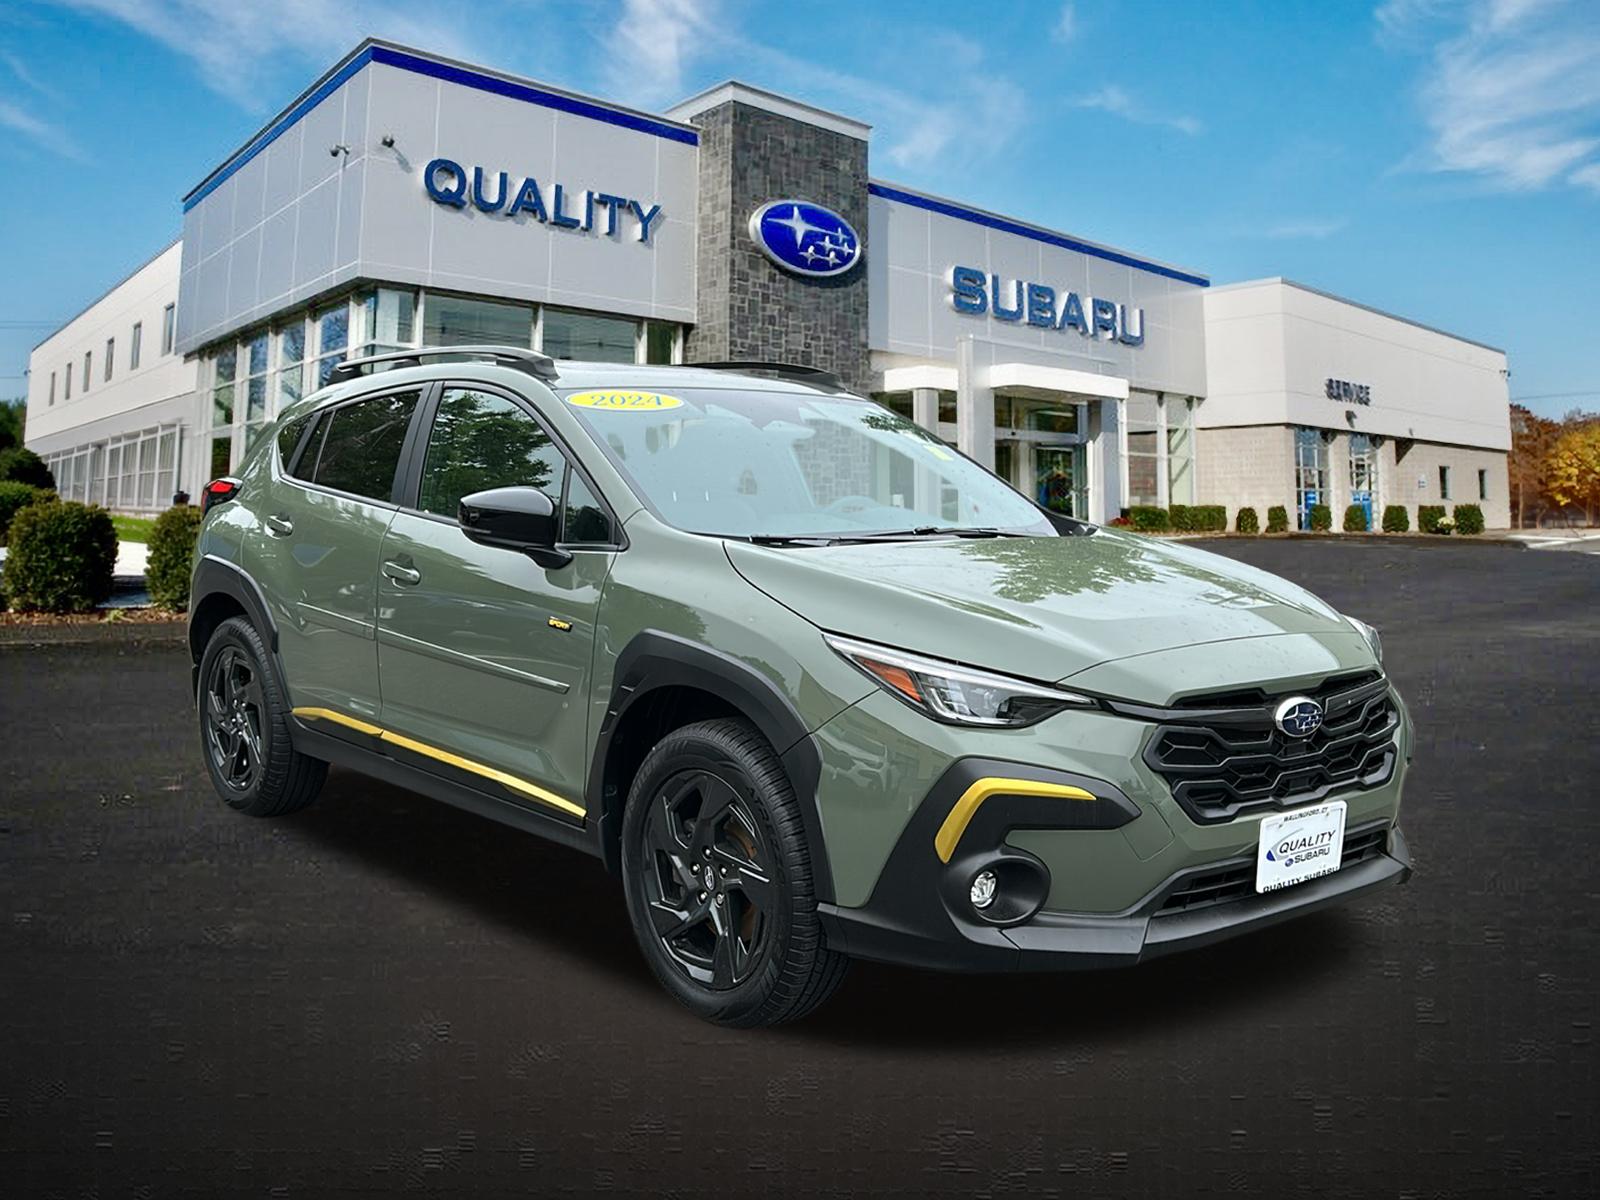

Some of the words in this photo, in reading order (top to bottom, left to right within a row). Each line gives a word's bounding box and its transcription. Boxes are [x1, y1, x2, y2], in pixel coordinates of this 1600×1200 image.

[424, 158, 661, 242] QUALITY
[950, 265, 1145, 346] SUBARU
[590, 394, 662, 406] 2024
[1325, 378, 1371, 406] SERVICE
[1279, 830, 1336, 854] QUALITY
[1294, 846, 1330, 863] SUBARU
[1262, 876, 1302, 892] QUALITY
[1303, 866, 1339, 881] SUBARU
